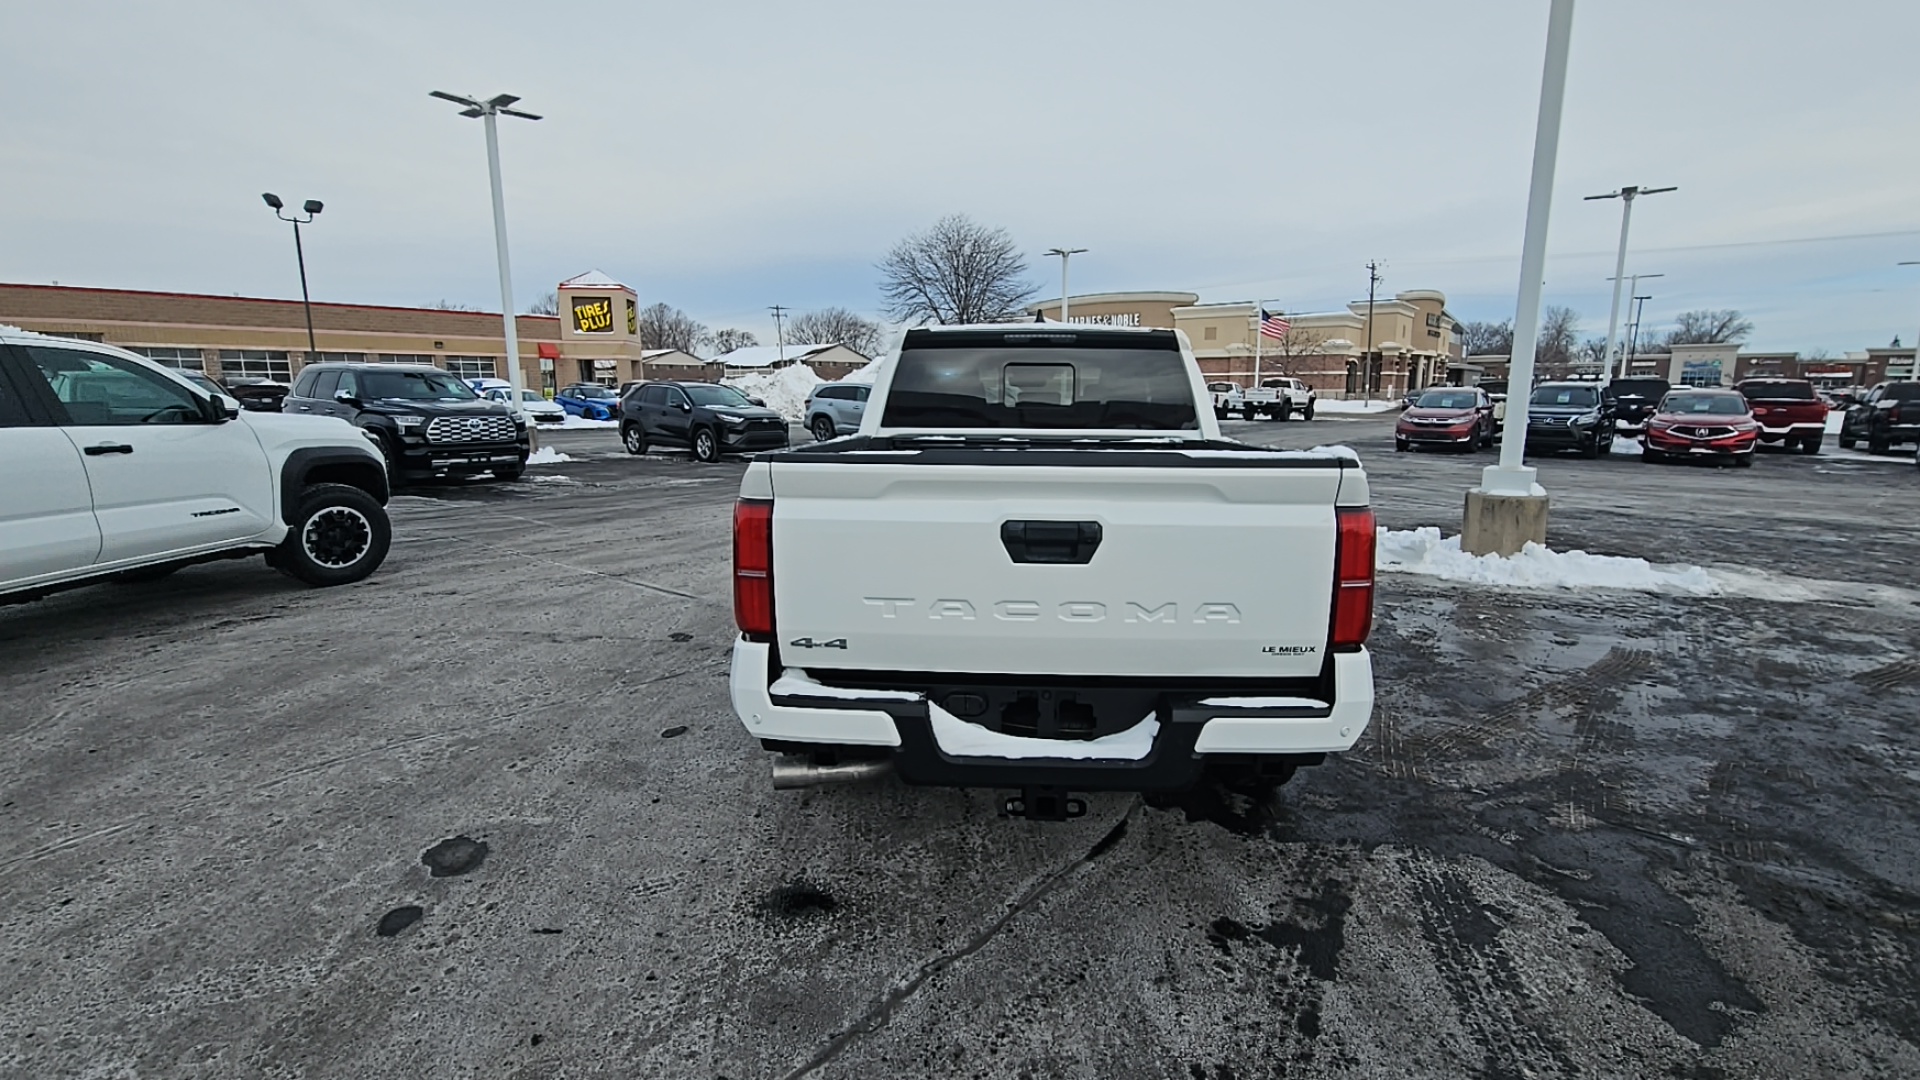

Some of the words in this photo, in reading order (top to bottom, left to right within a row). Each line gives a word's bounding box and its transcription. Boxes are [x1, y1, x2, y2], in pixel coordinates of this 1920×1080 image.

[574, 300, 609, 320] TIRES
[580, 313, 611, 332] PLUS
[190, 508, 240, 517] TACOMA
[862, 596, 1242, 624] TACOMA
[790, 637, 848, 649] 4x4
